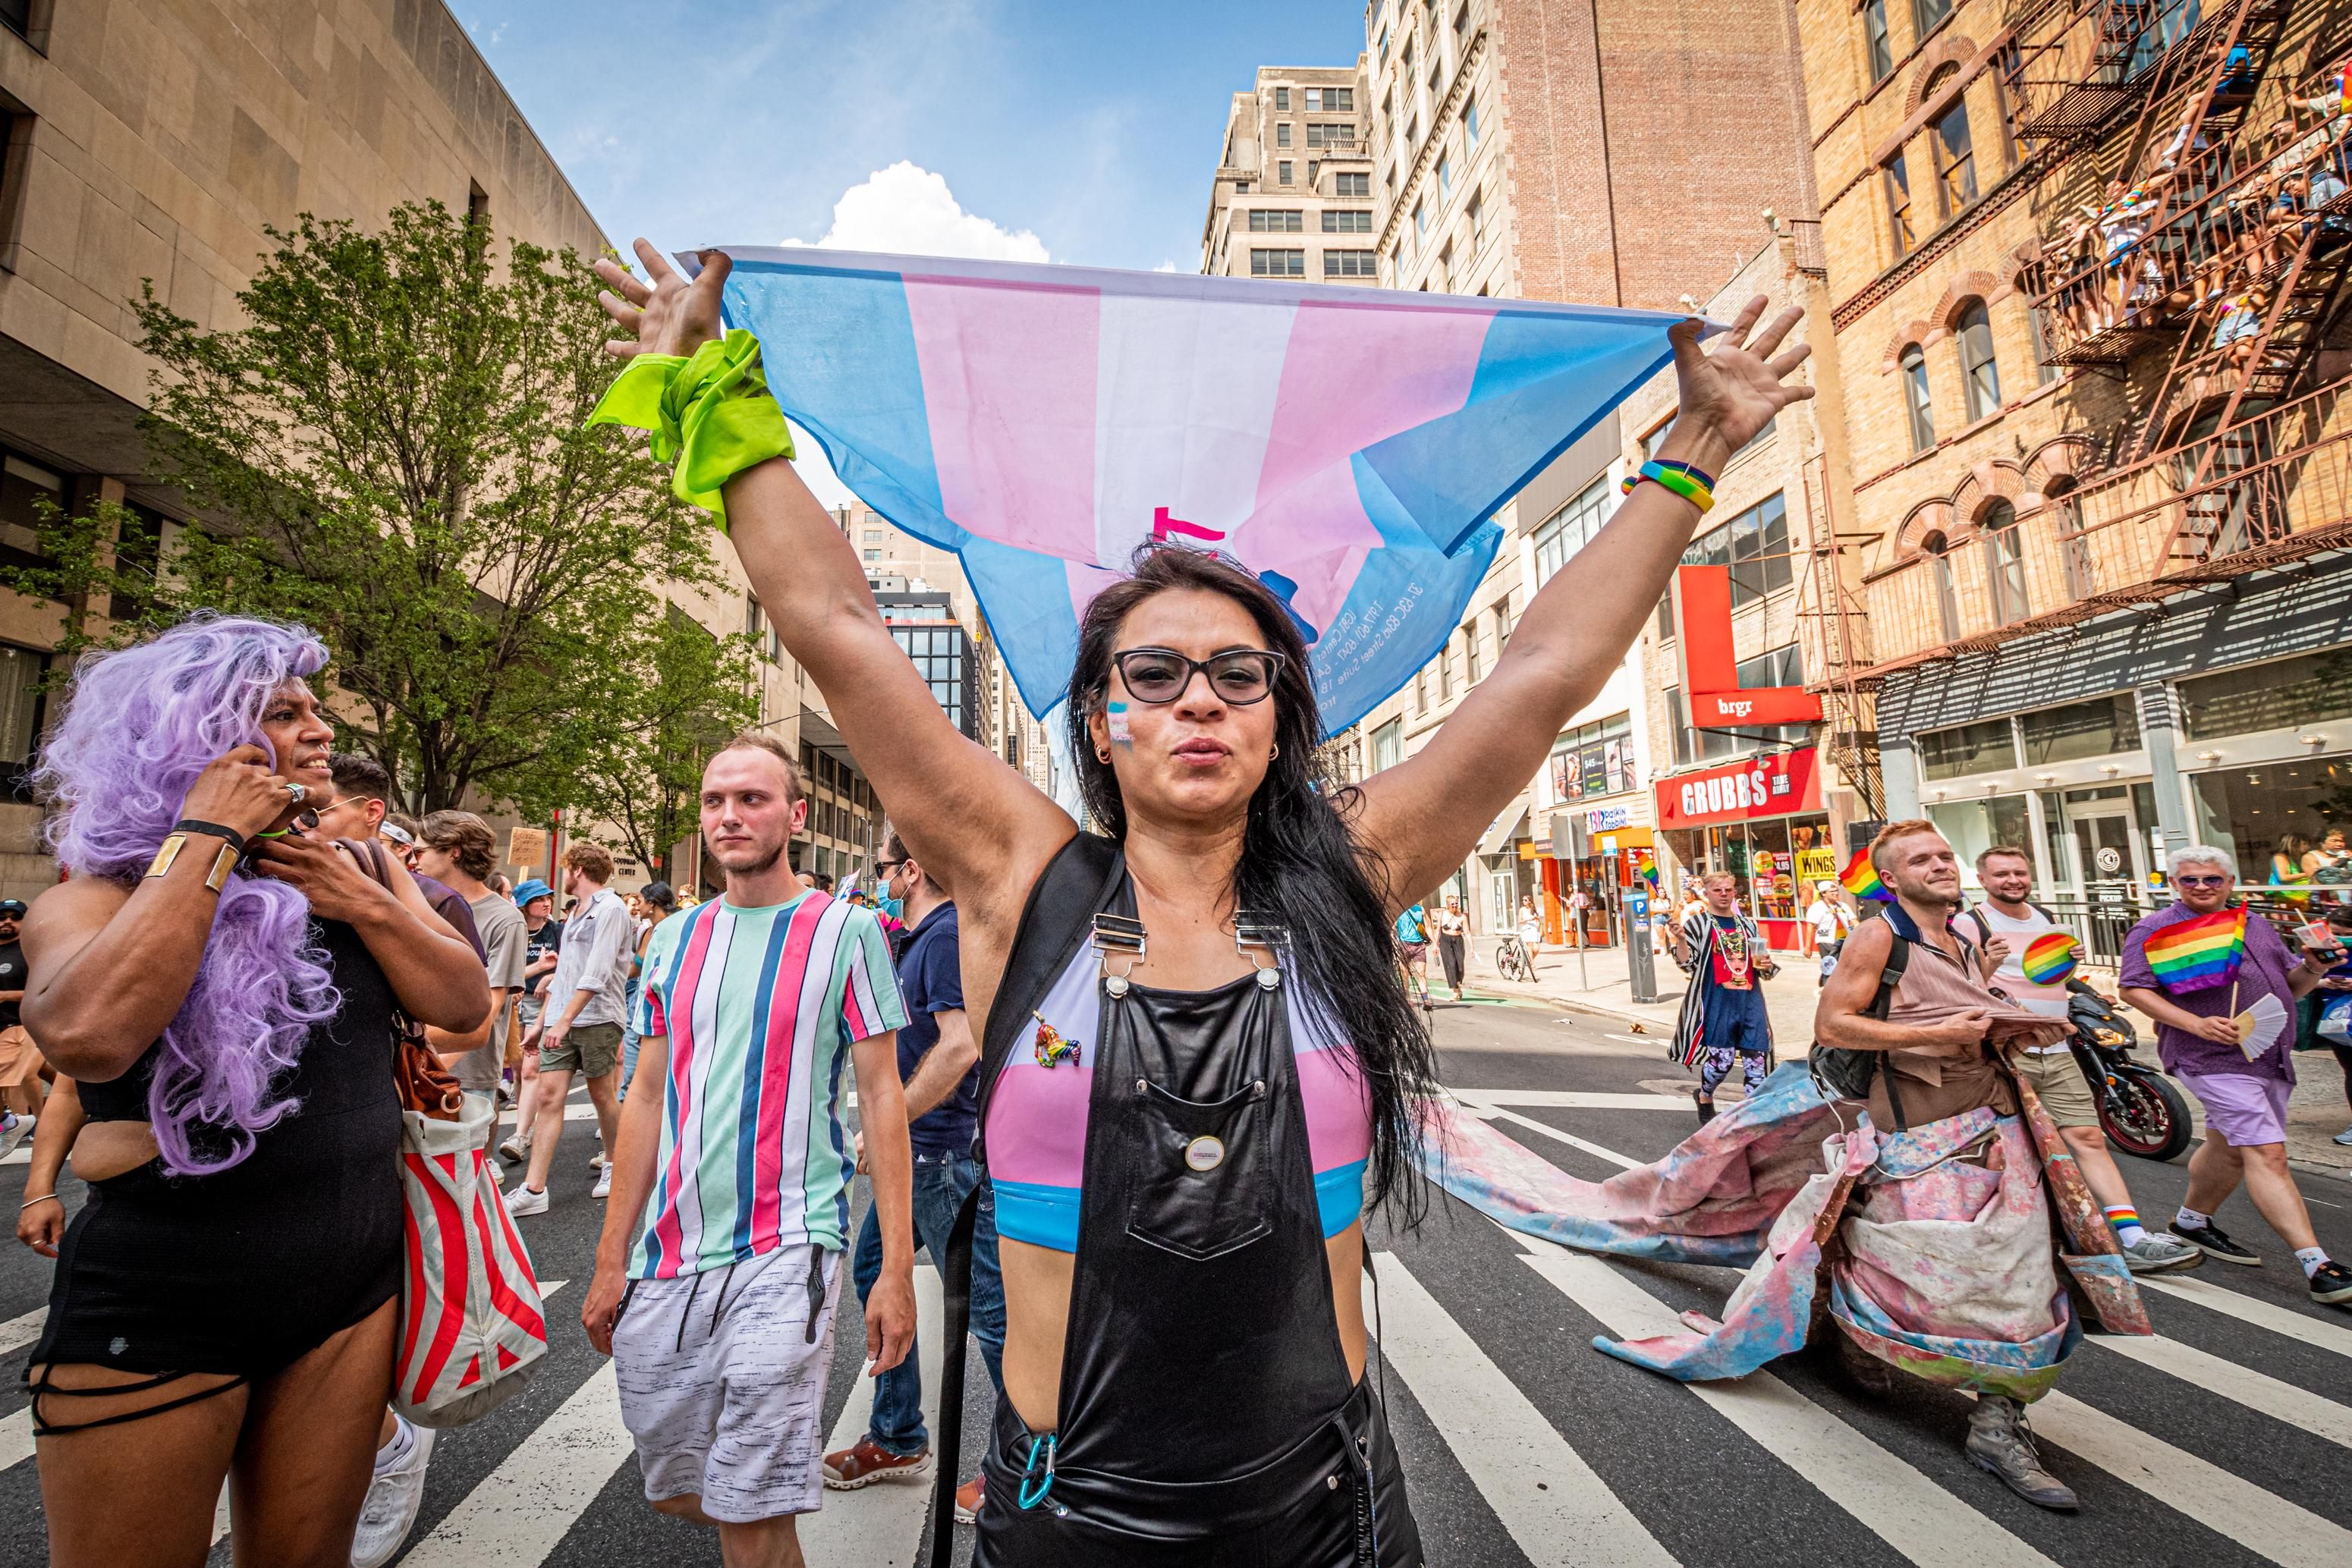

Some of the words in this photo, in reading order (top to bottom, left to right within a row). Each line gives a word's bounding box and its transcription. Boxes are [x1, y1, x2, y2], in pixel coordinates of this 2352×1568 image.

[1718, 699, 1753, 717] brgr
[1584, 758, 1596, 769] $45
[1772, 775, 1789, 785] TAKE
[1681, 770, 1767, 816] GRUBBS
[1605, 807, 1626, 819] baskin
[1605, 818, 1627, 829] robbins
[1802, 856, 1836, 873] WINGS
[1637, 901, 1644, 913] P
